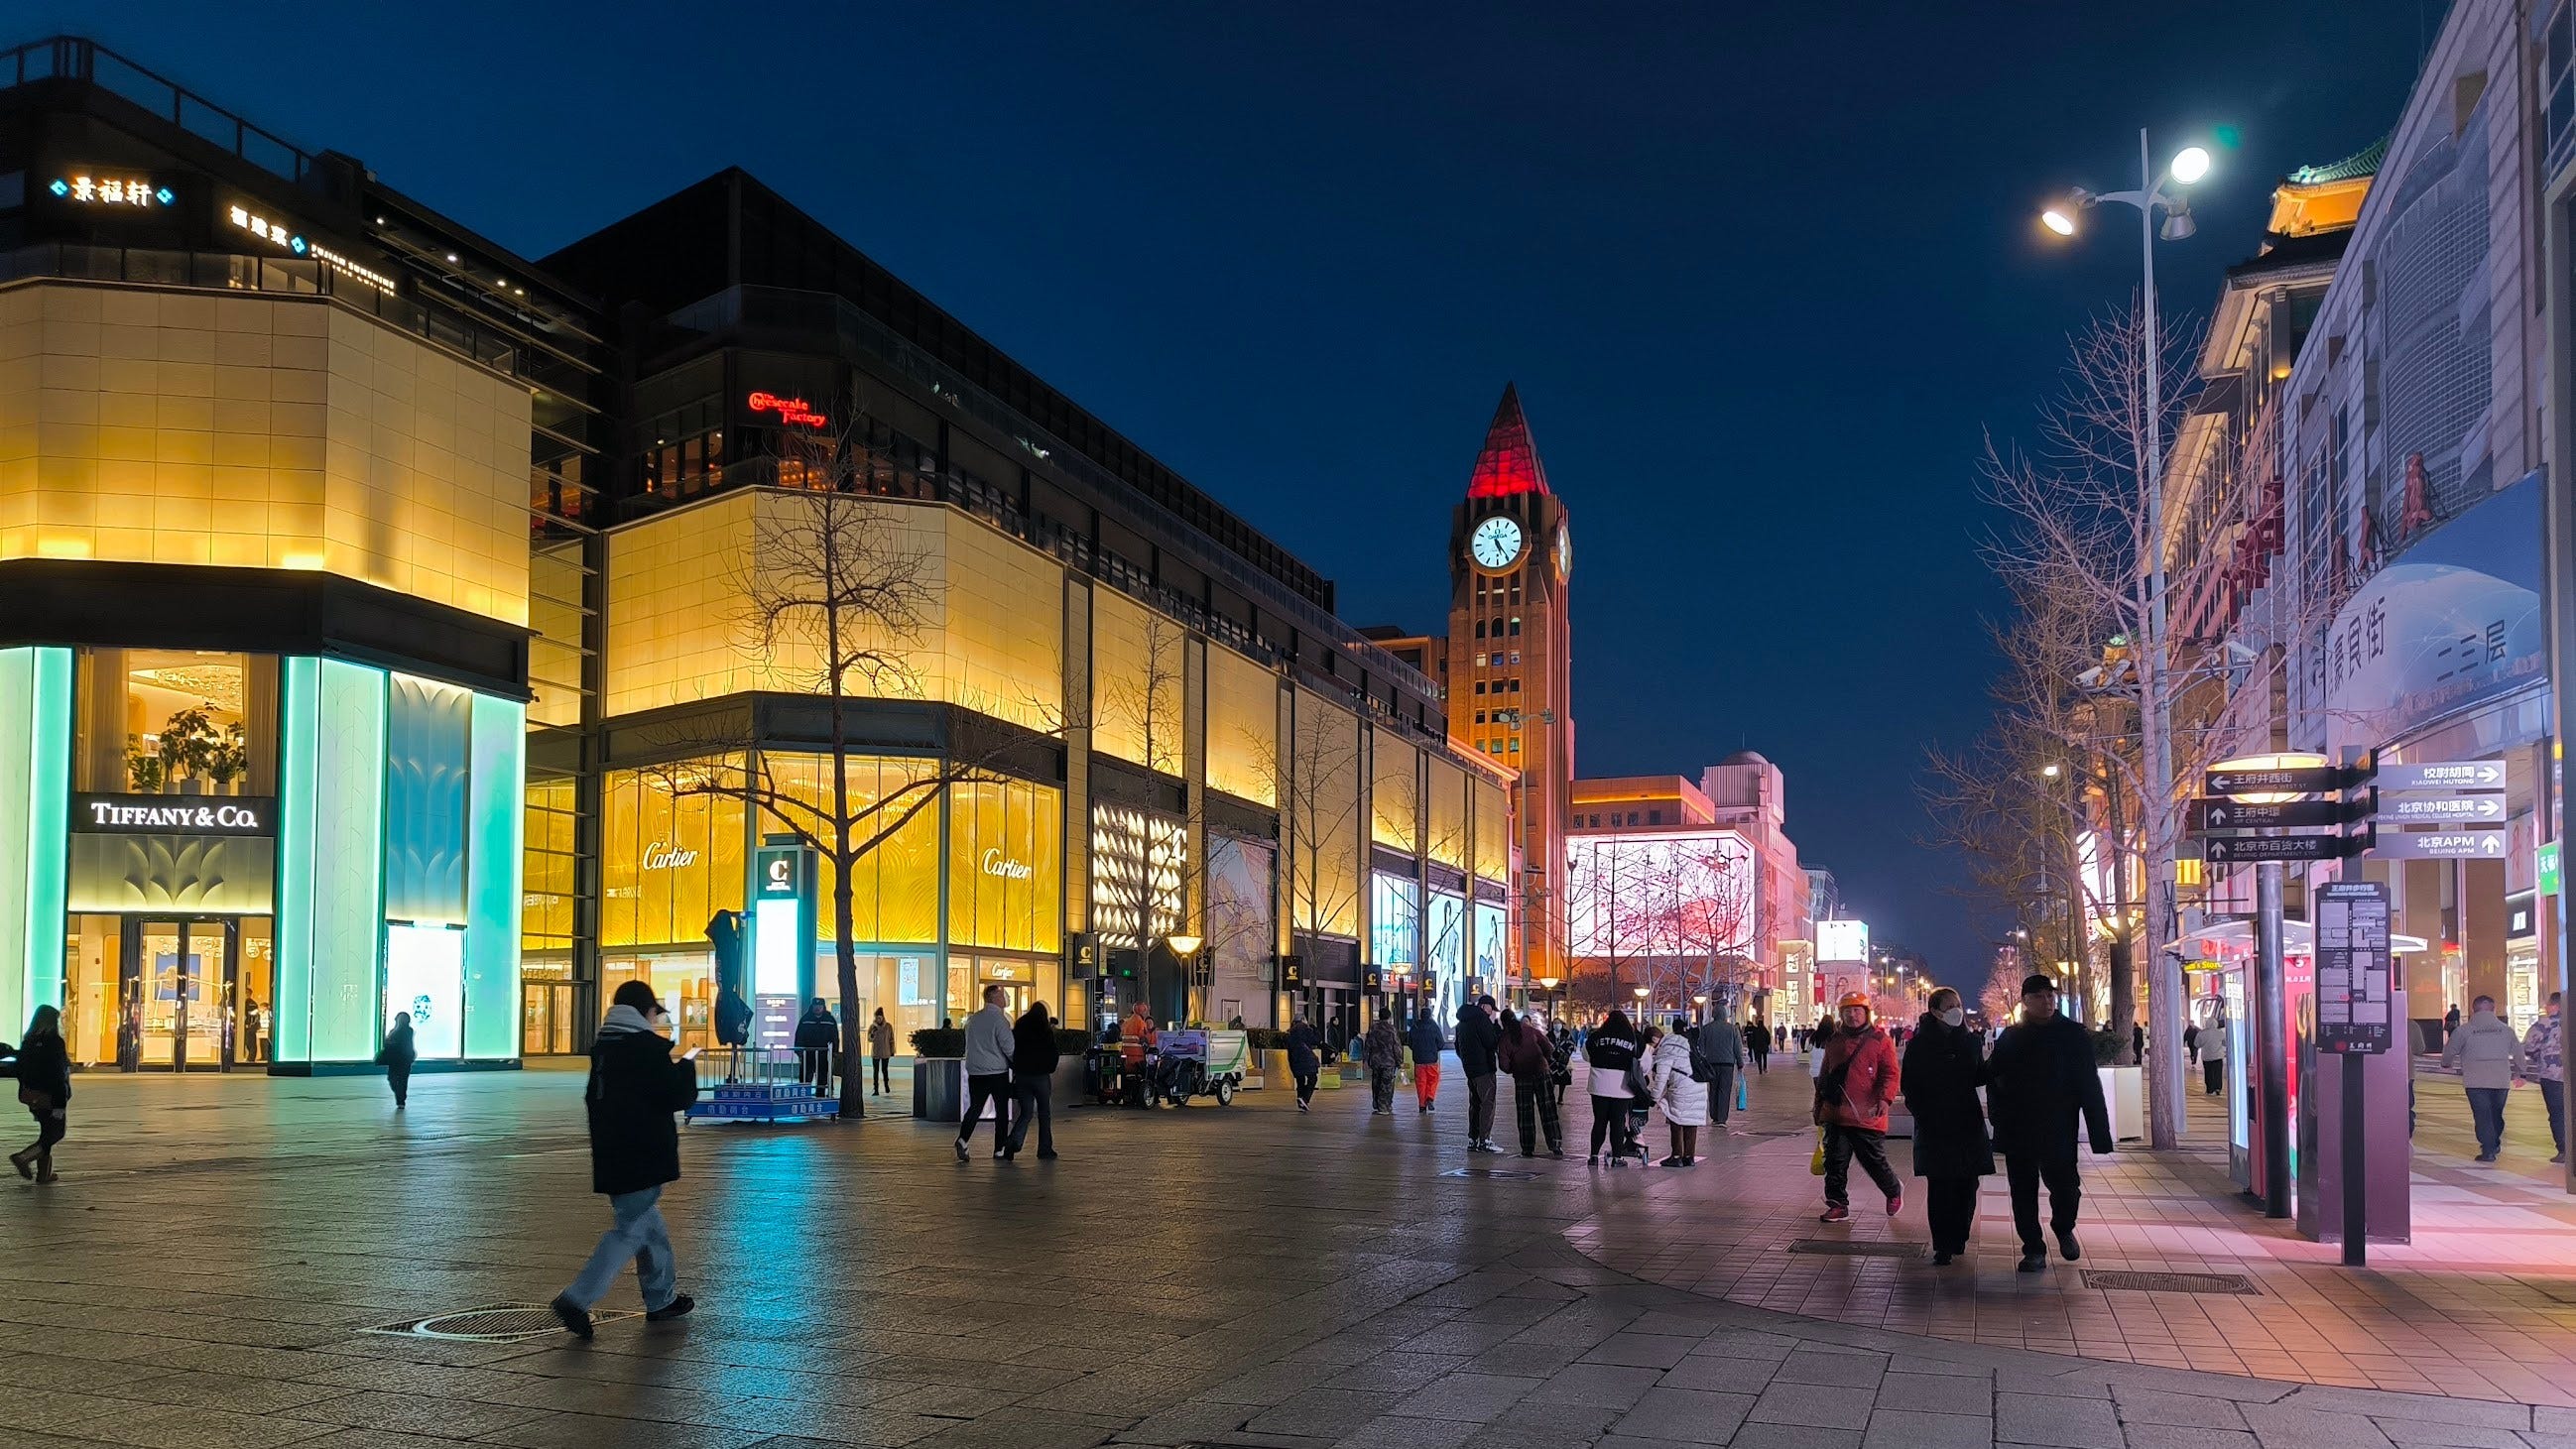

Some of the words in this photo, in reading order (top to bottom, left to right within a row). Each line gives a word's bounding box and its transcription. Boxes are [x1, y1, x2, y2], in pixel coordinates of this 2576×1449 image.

[71, 177, 152, 206] 景福轩
[779, 408, 825, 426] Factory
[2436, 619, 2508, 682] 二三层
[2234, 773, 2292, 785] 王府井西街
[2424, 766, 2475, 780] 校尉胡同
[2398, 799, 2475, 813] 北京协和医院
[2234, 839, 2317, 852] 北京市百货大楼
[2417, 836, 2475, 848] 北京APM
[643, 841, 698, 870] Cartier
[983, 848, 1032, 880] Cartier
[992, 962, 1015, 980] Cartier
